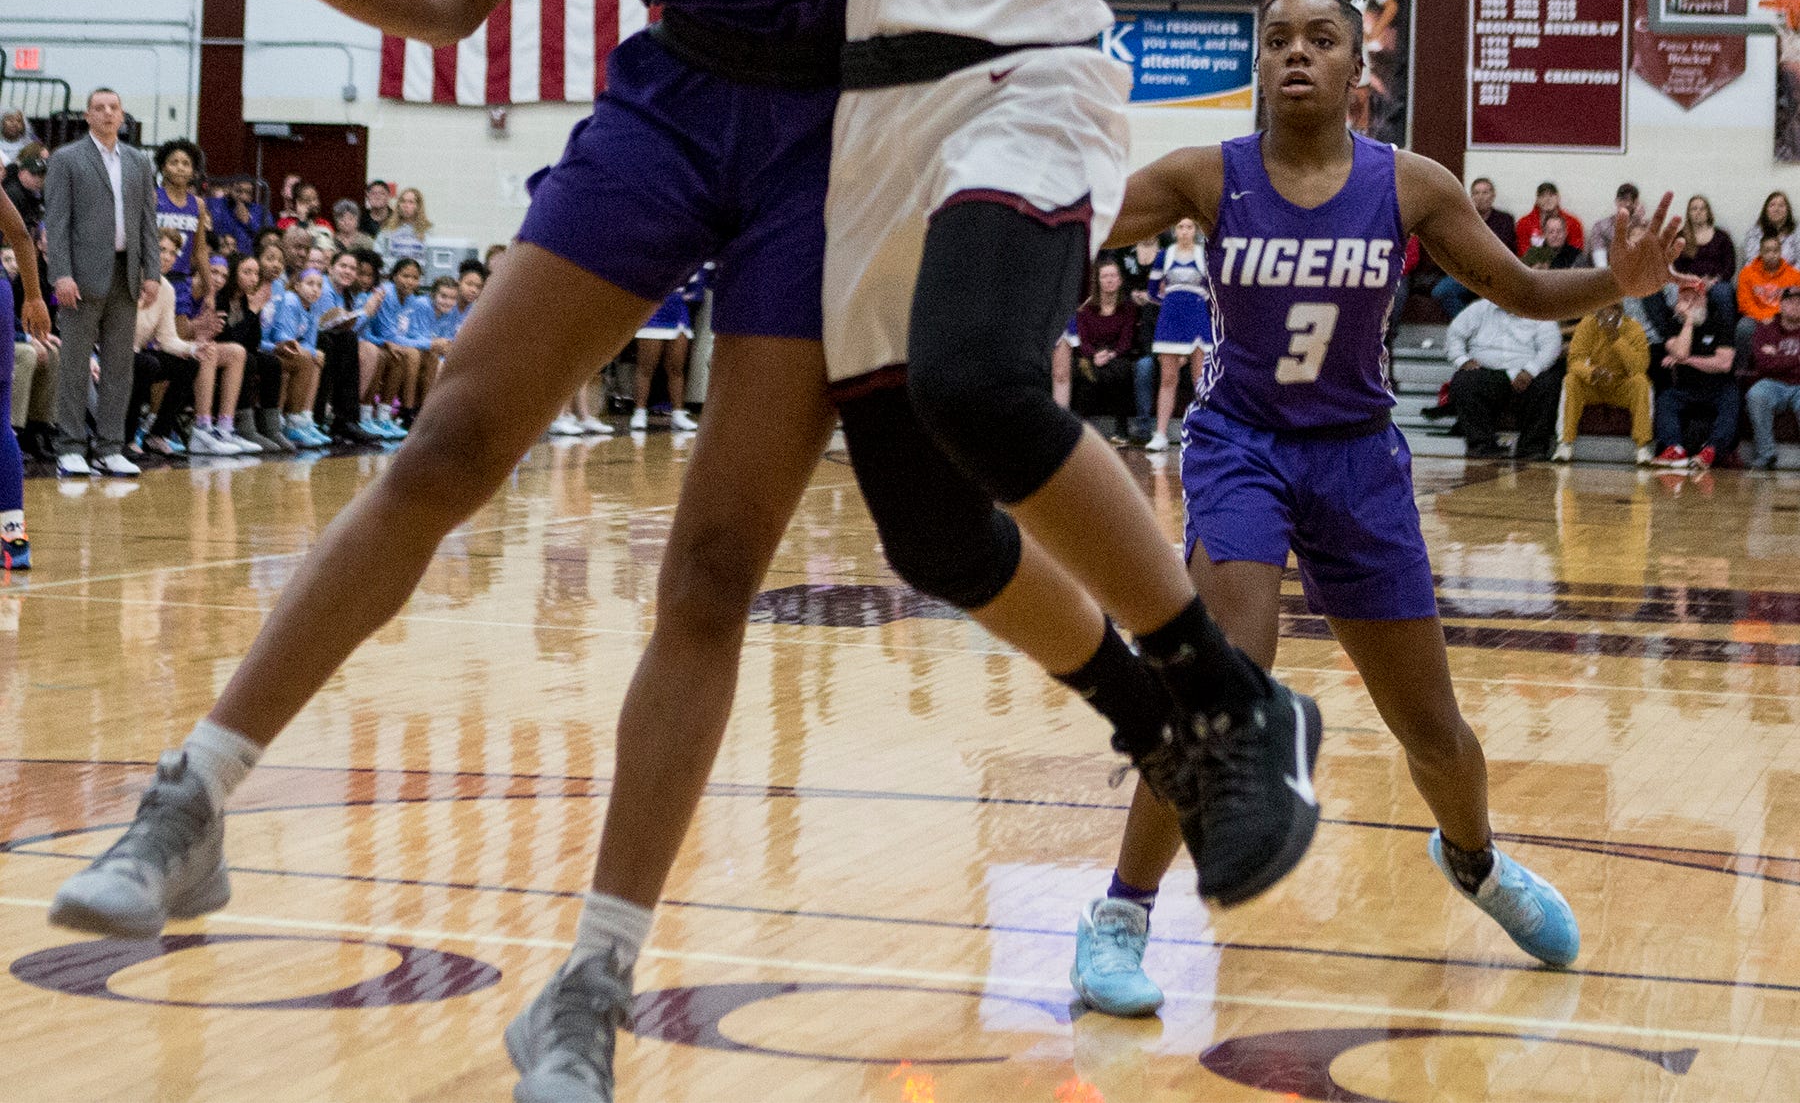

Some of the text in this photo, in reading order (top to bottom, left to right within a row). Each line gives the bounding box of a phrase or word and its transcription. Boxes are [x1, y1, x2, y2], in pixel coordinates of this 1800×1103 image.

[1143, 20, 1239, 35] The resources
[1476, 21, 1541, 35] REGIONAL
[1142, 38, 1249, 52] you want, and the
[1141, 55, 1239, 73] attention you
[1140, 73, 1190, 86] deserve.
[1473, 69, 1620, 85] REGIONAL CHAMPIONS
[1220, 236, 1395, 288] TIGERS
[1274, 301, 1341, 385] 3
